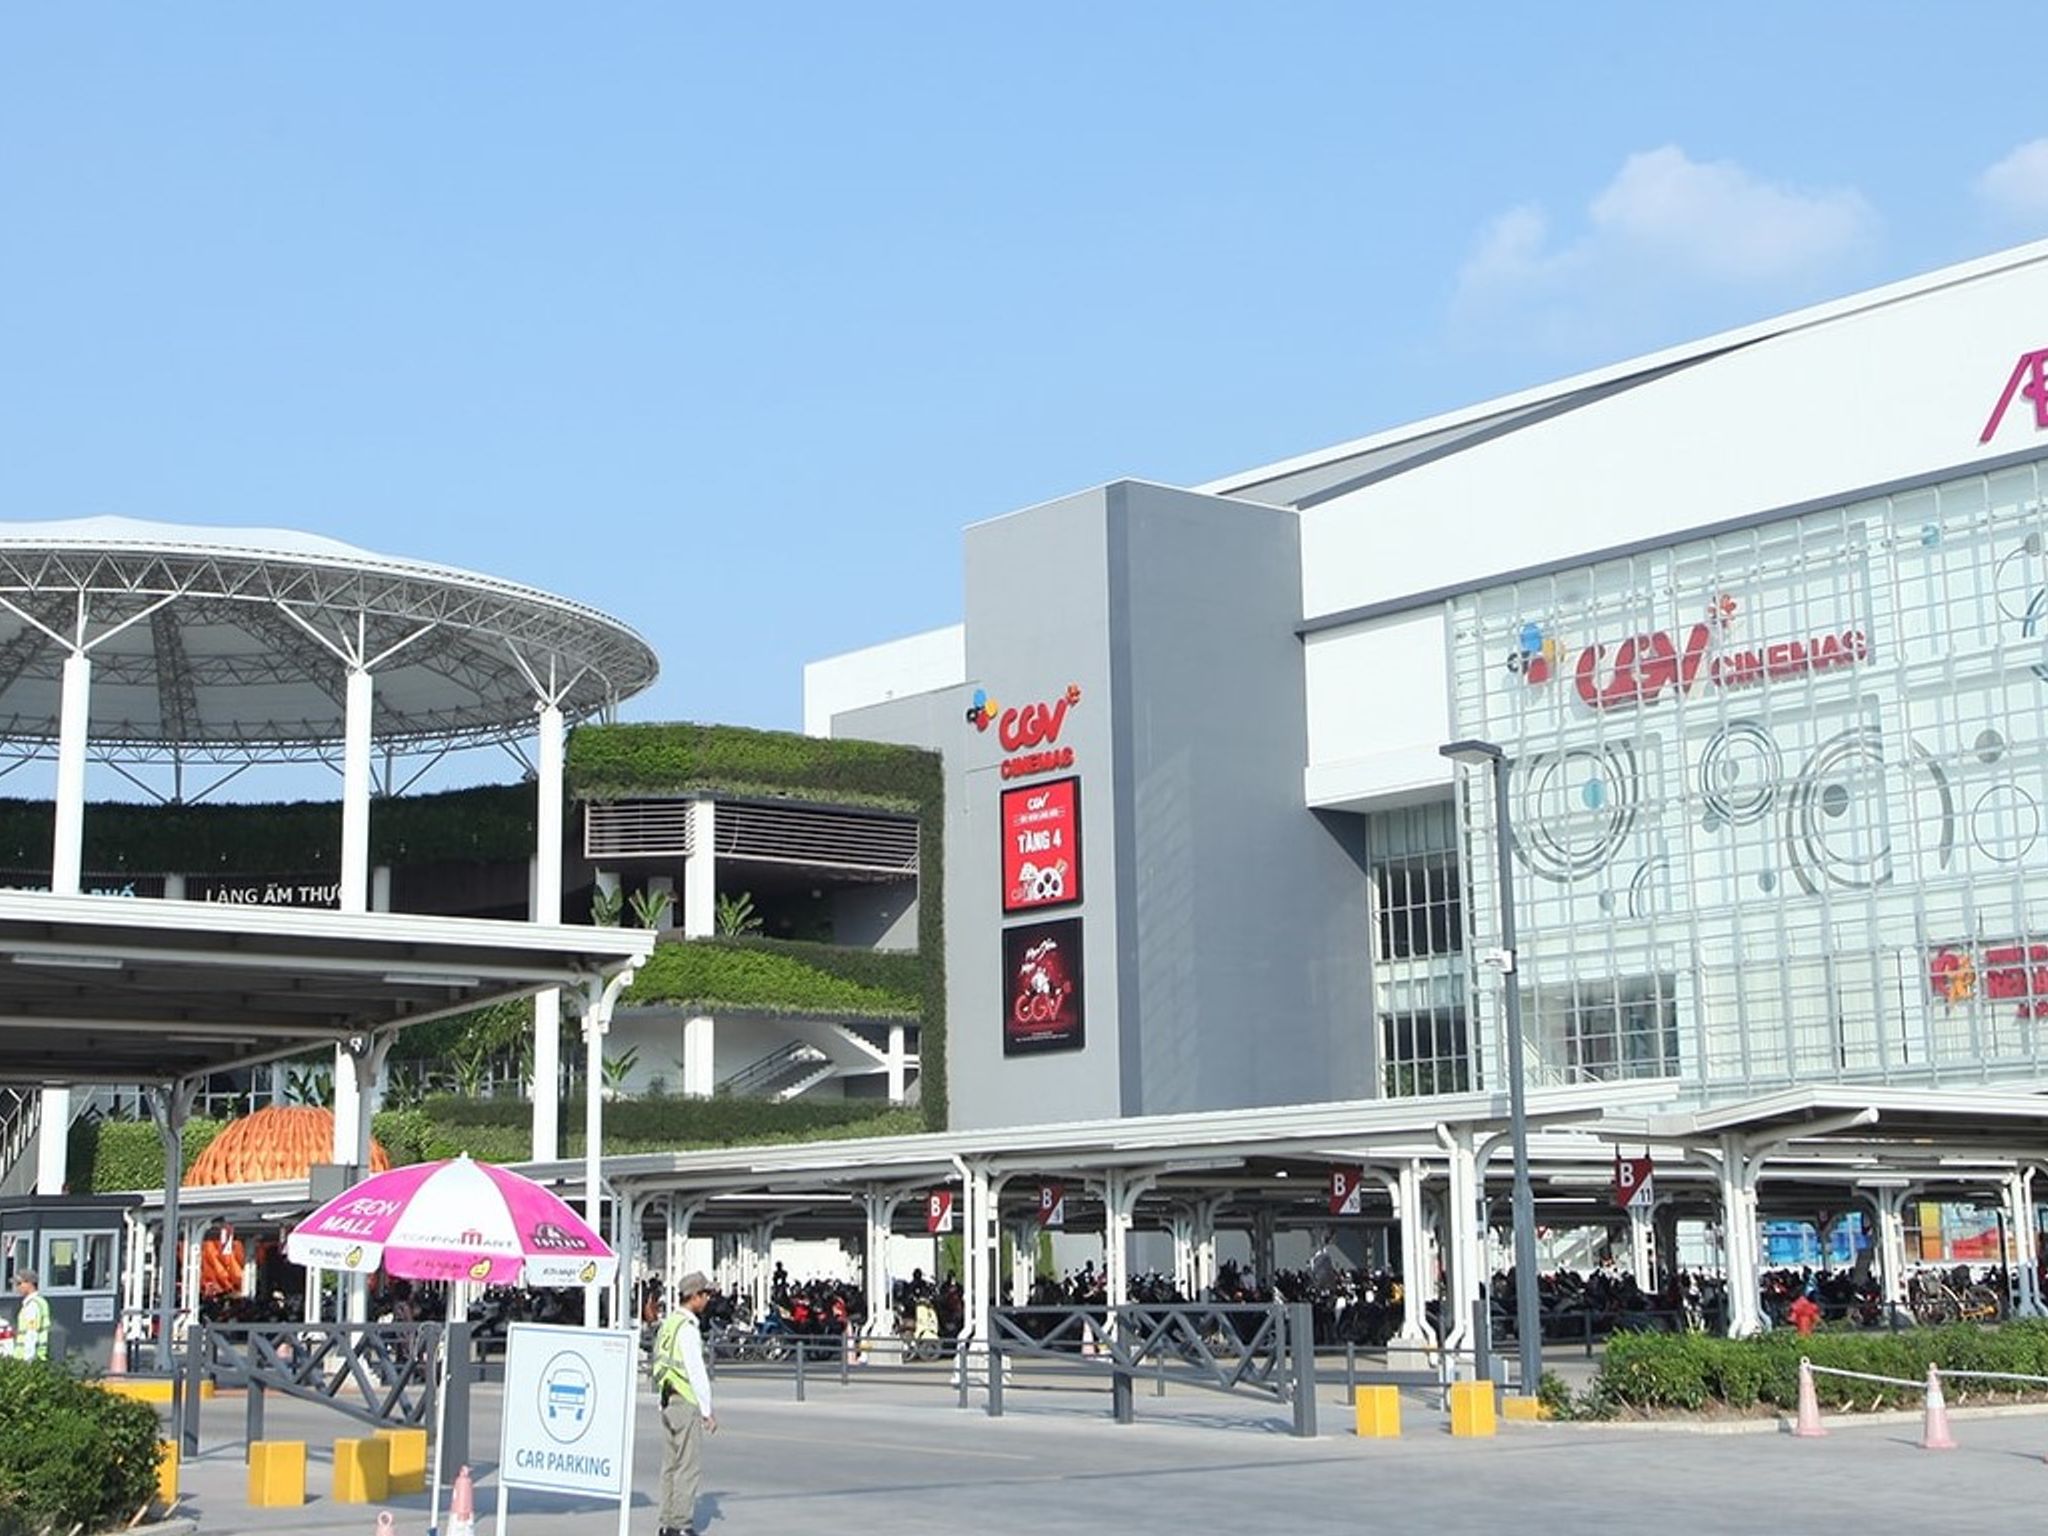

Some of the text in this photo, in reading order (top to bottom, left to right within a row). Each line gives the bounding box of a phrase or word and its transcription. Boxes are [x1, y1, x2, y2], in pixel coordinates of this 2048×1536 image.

[1575, 622, 1867, 712] CGV CINEMAS
[999, 699, 1069, 751] CGV
[1001, 747, 1075, 779] CINEMAS
[1053, 828, 1062, 848] 4
[206, 884, 258, 904] LÀNG
[1334, 1173, 1346, 1196] B
[1620, 1162, 1634, 1187] B
[931, 1196, 940, 1217] B
[1043, 1188, 1052, 1209] B
[1640, 1188, 1651, 1203] 11
[318, 1215, 377, 1235] MALL
[514, 1448, 611, 1478] CAR PARKING
